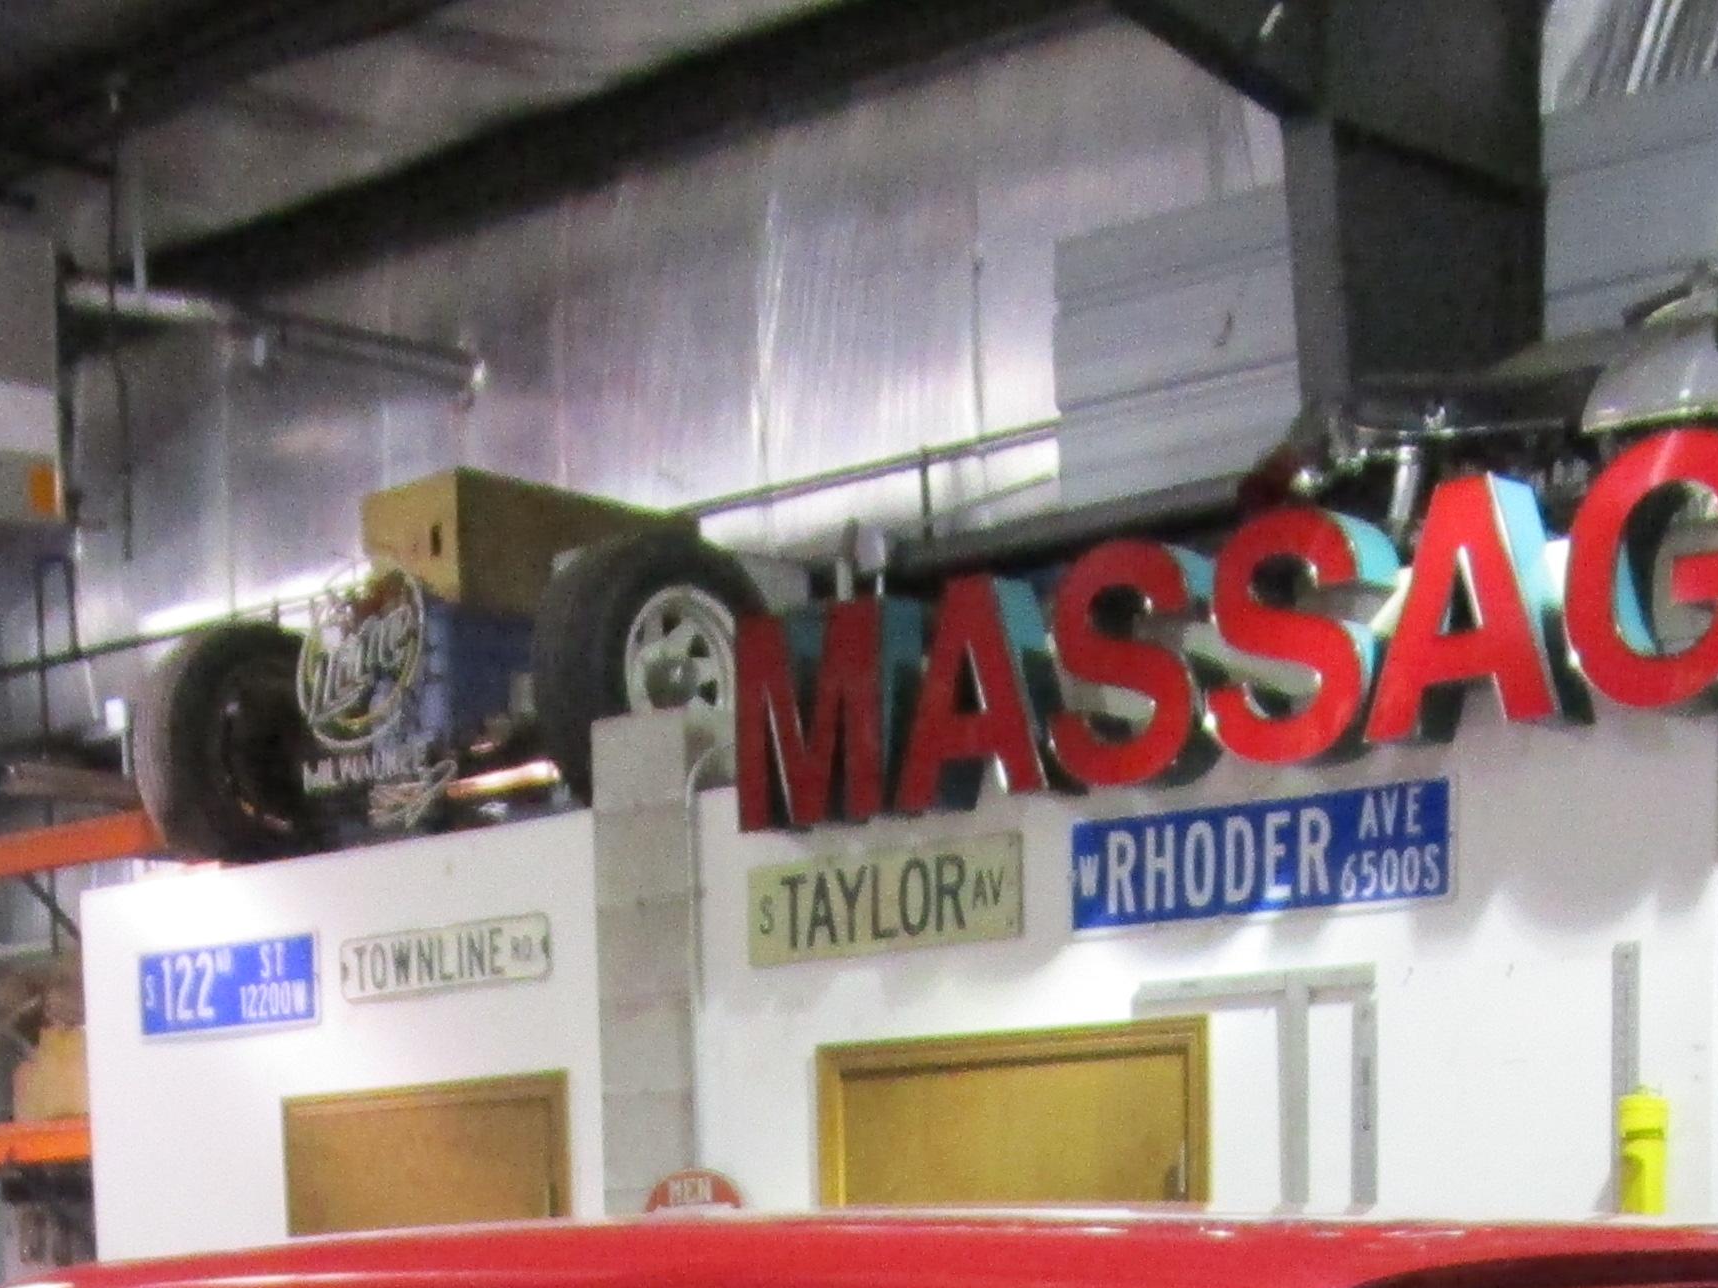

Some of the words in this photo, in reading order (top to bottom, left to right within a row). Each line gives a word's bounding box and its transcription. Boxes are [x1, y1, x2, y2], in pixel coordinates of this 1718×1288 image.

[1077, 853, 1099, 898] W
[1106, 806, 1332, 916] RHODER
[1357, 786, 1423, 841] AVE
[1339, 843, 1440, 899] 6500S
[758, 893, 775, 936] S
[780, 853, 967, 949] TAYLOR
[972, 866, 1005, 909] AV
[259, 947, 285, 979] ST
[352, 926, 506, 992] TOWNLINE
